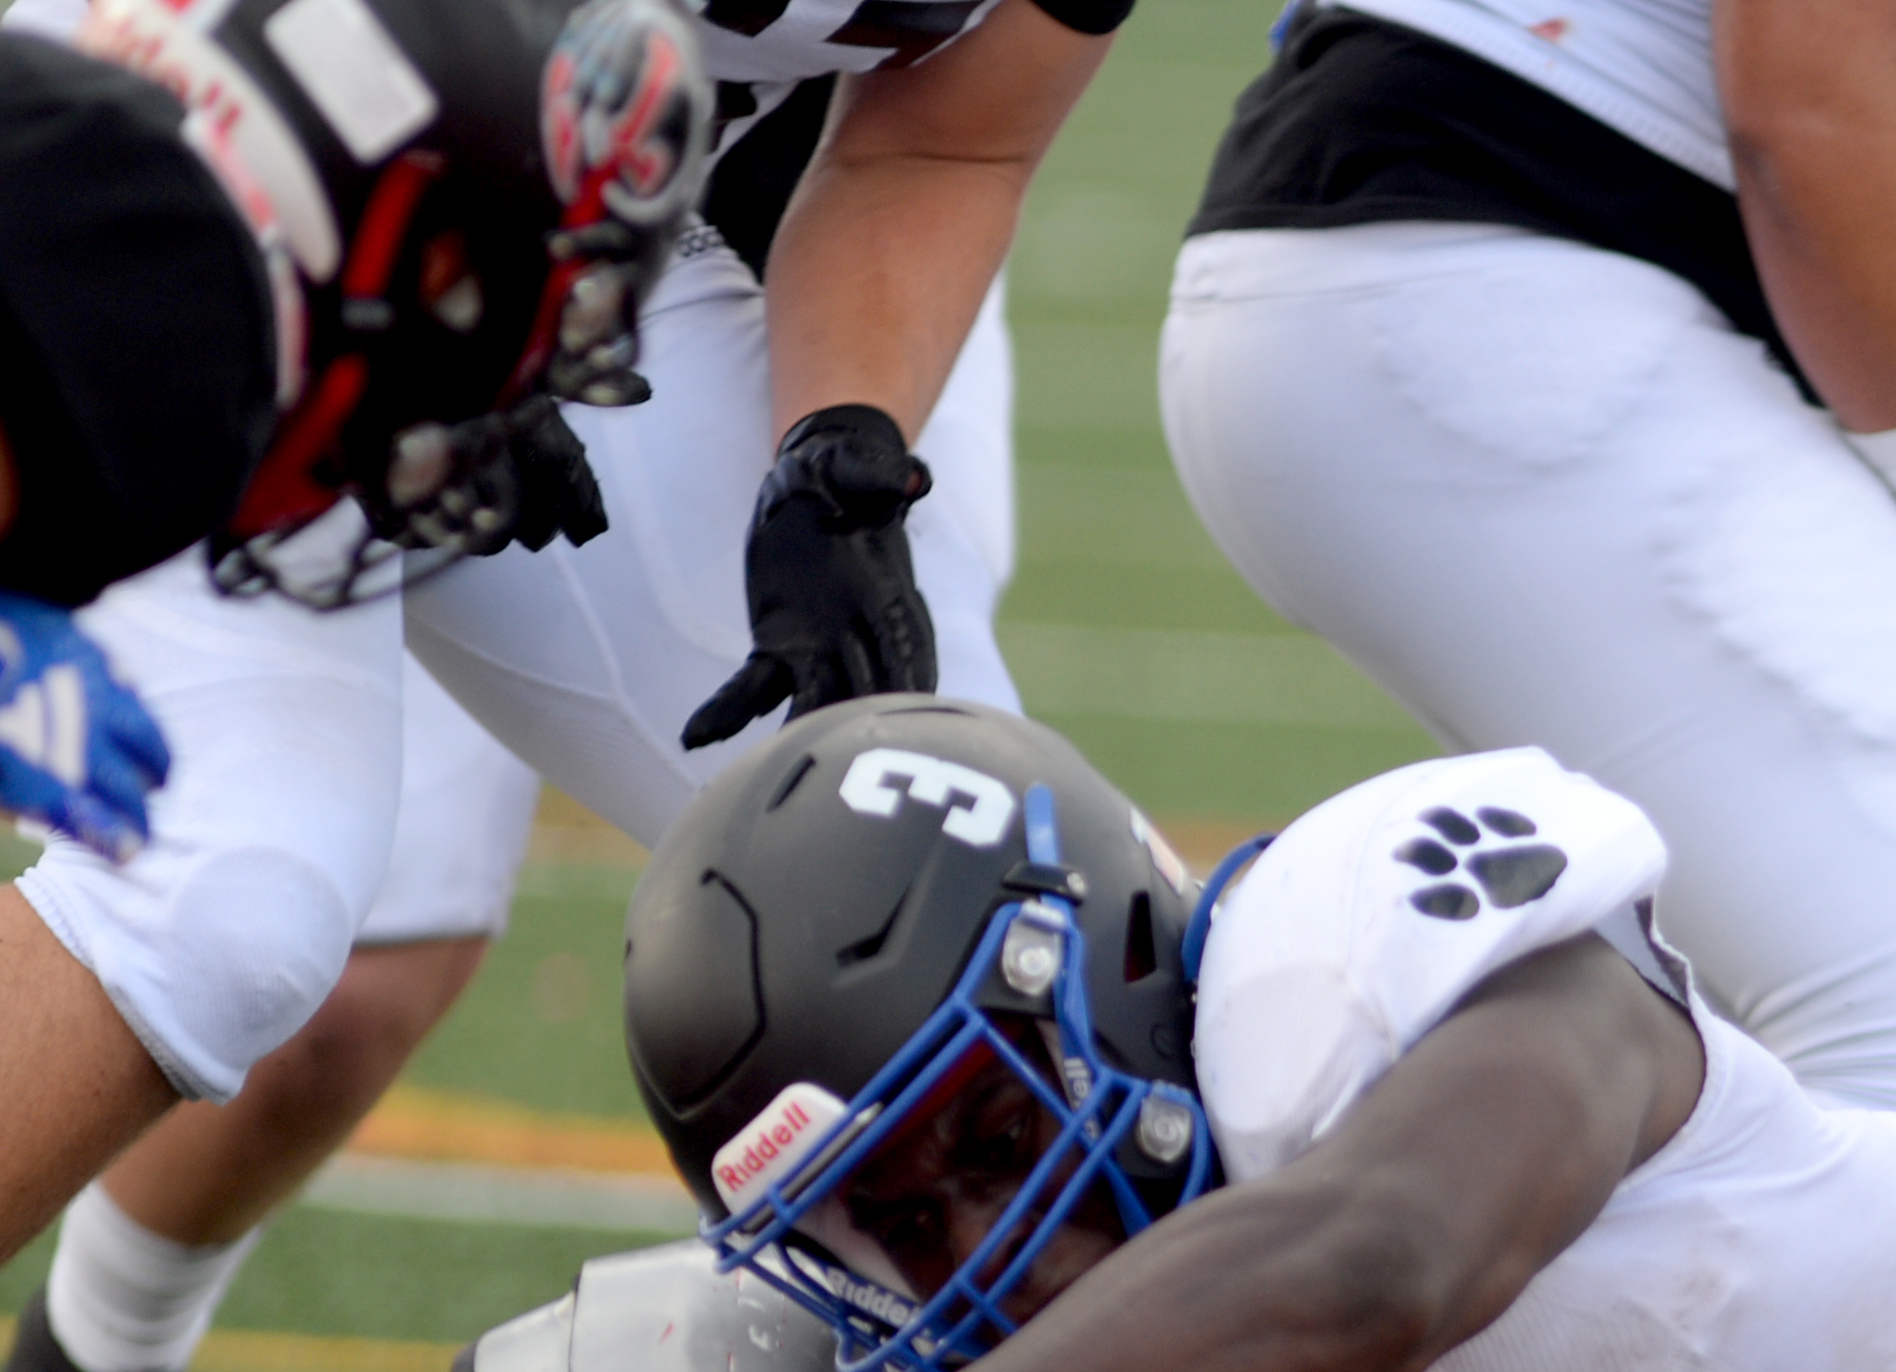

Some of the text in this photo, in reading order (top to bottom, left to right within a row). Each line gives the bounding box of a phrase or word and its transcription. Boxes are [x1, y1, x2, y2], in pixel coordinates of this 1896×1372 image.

[838, 747, 1016, 847] 3
[717, 1101, 810, 1192] Riddell
[826, 1266, 923, 1329] Ridde
